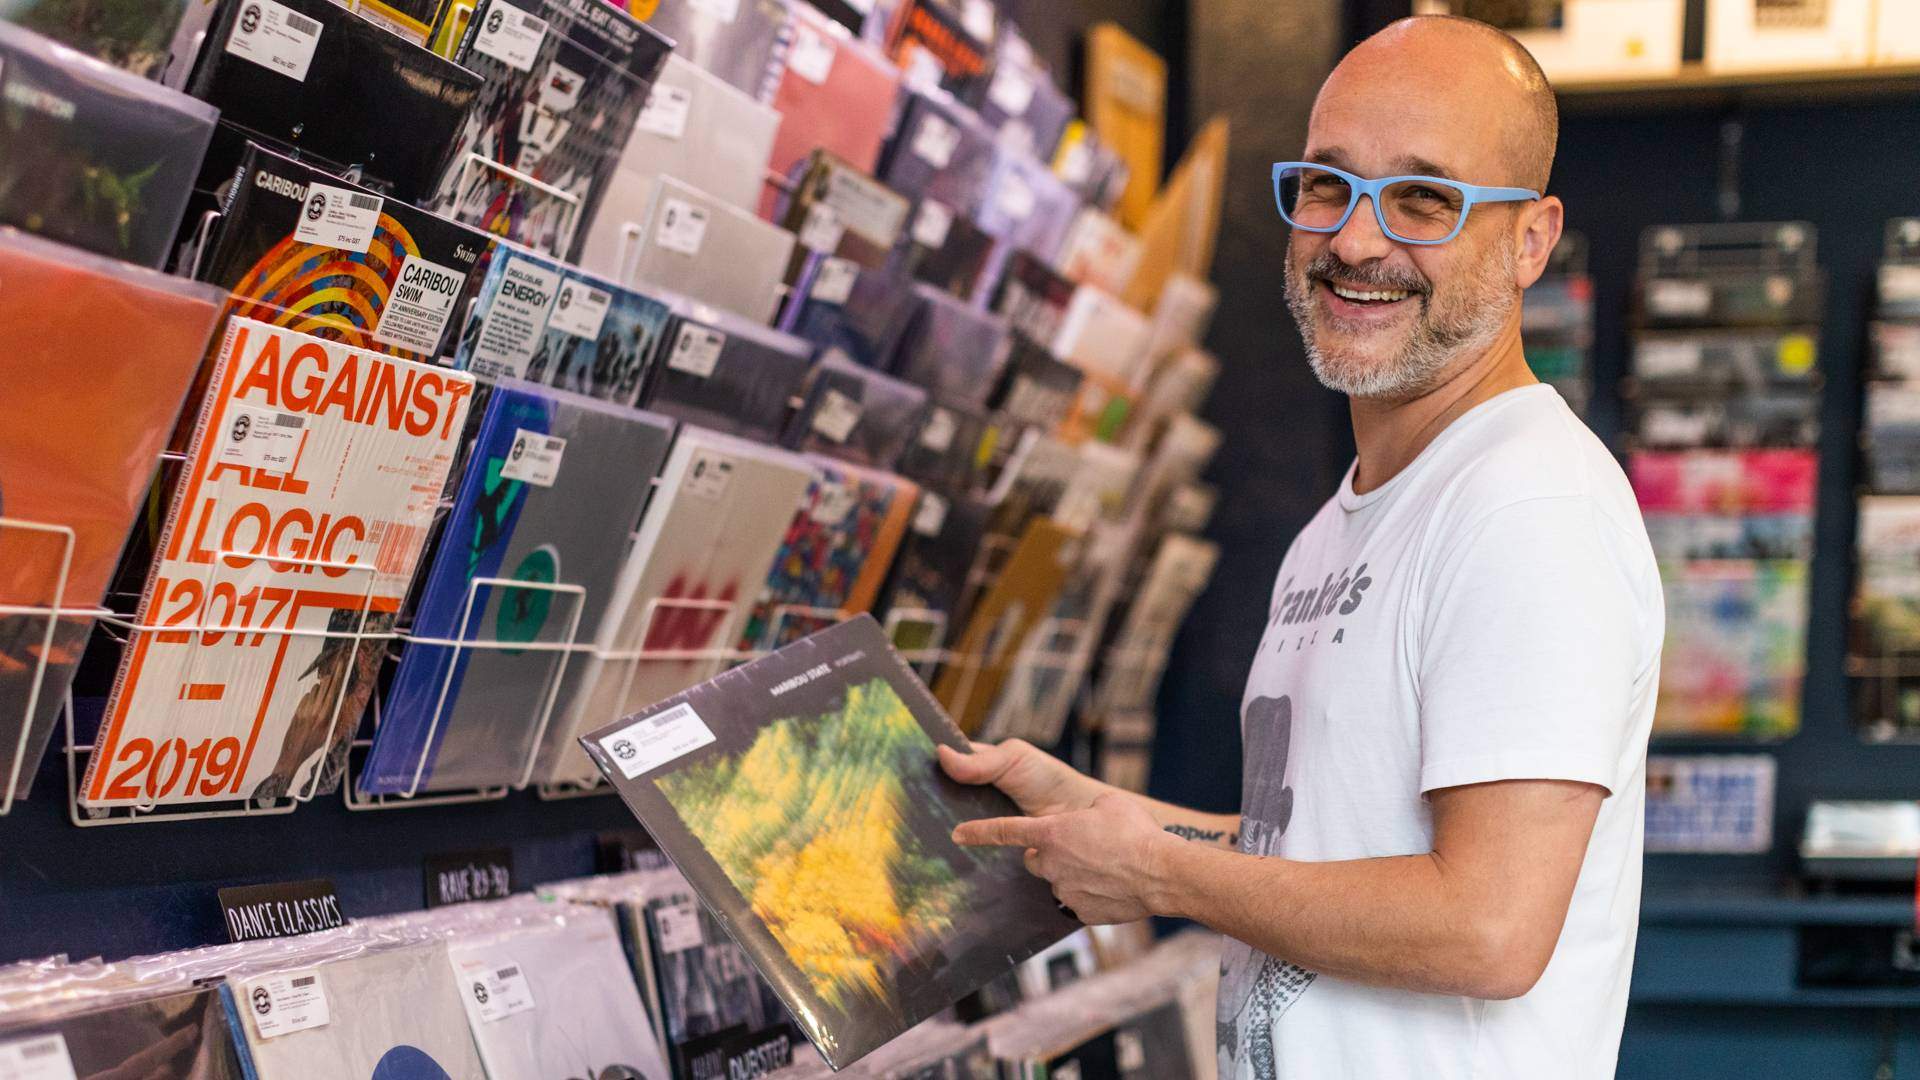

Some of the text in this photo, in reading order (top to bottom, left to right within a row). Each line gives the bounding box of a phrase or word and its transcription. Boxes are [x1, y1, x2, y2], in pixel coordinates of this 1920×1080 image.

[255, 170, 309, 202] CARIBOU
[453, 244, 477, 264] Swim
[395, 284, 424, 304] SWIM
[403, 264, 460, 296] CARIBOU
[501, 279, 551, 308] ENERGY
[507, 268, 544, 287] DISCLOSURE
[398, 305, 428, 320] ANNIVERSARY
[427, 314, 443, 324] EDITION
[234, 335, 474, 440] AGAINST
[186, 498, 365, 579] LOGIC
[80, 323, 237, 797] OTHER PEOPLE OTHER PEOPLE OTHER PEOPLE OTHER PEOPLE OTHE PEOPLE OTHER PEOPLE OTHER PEOPLE
[155, 578, 294, 647] 2017
[1270, 563, 1373, 627] rankie's
[769, 673, 809, 697] MARIBOU
[805, 662, 833, 681] STATE
[103, 736, 242, 799] 2019
[438, 869, 472, 903] RAVE
[228, 894, 344, 941] DANCE CLASSICS
[728, 1035, 790, 1080] DUBSTEP
